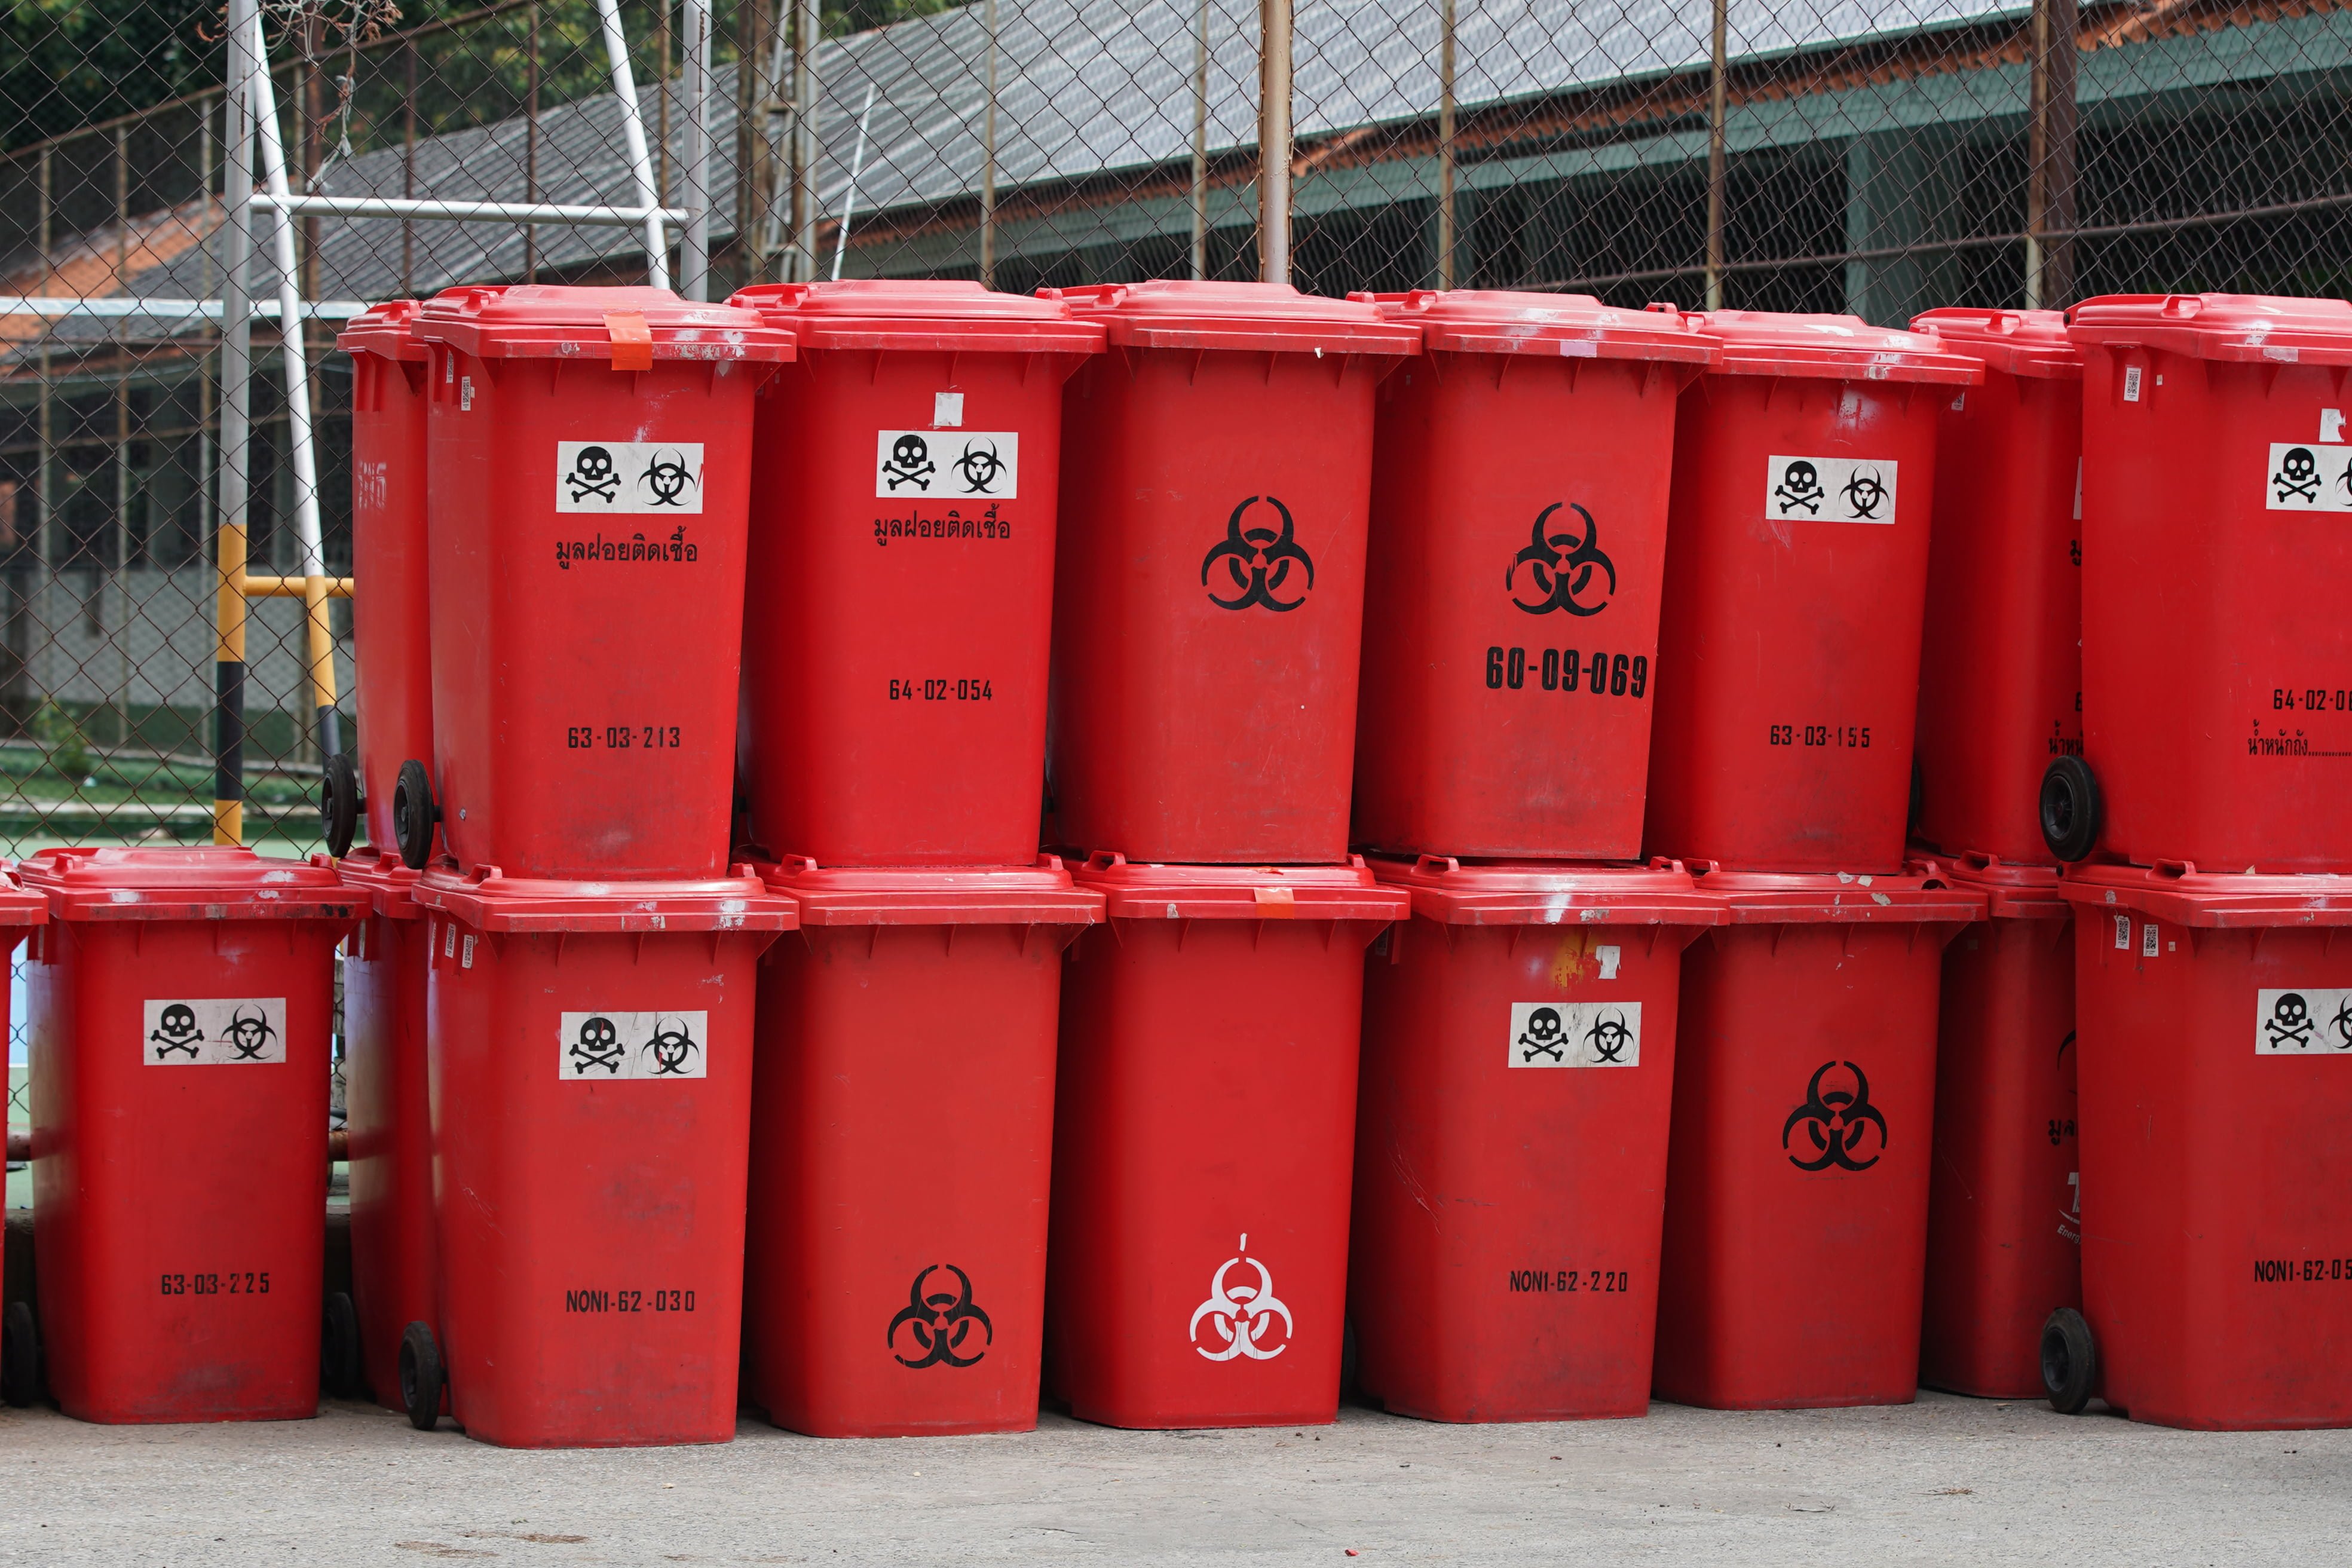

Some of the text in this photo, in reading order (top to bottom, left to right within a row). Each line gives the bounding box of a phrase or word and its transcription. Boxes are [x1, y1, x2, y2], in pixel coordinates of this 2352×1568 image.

[874, 503, 1010, 546] มูลฝอยติดเชื้อ
[556, 525, 698, 569] มูลฝอยติดเชื้อ
[1486, 646, 1647, 699] 60-09-069
[889, 679, 992, 700] 64-02-054
[568, 726, 680, 748] 63-03-213
[1770, 725, 1870, 748] 63-03-155
[2057, 1224, 2080, 1245] Energ
[161, 1272, 269, 1294] 63-03-225
